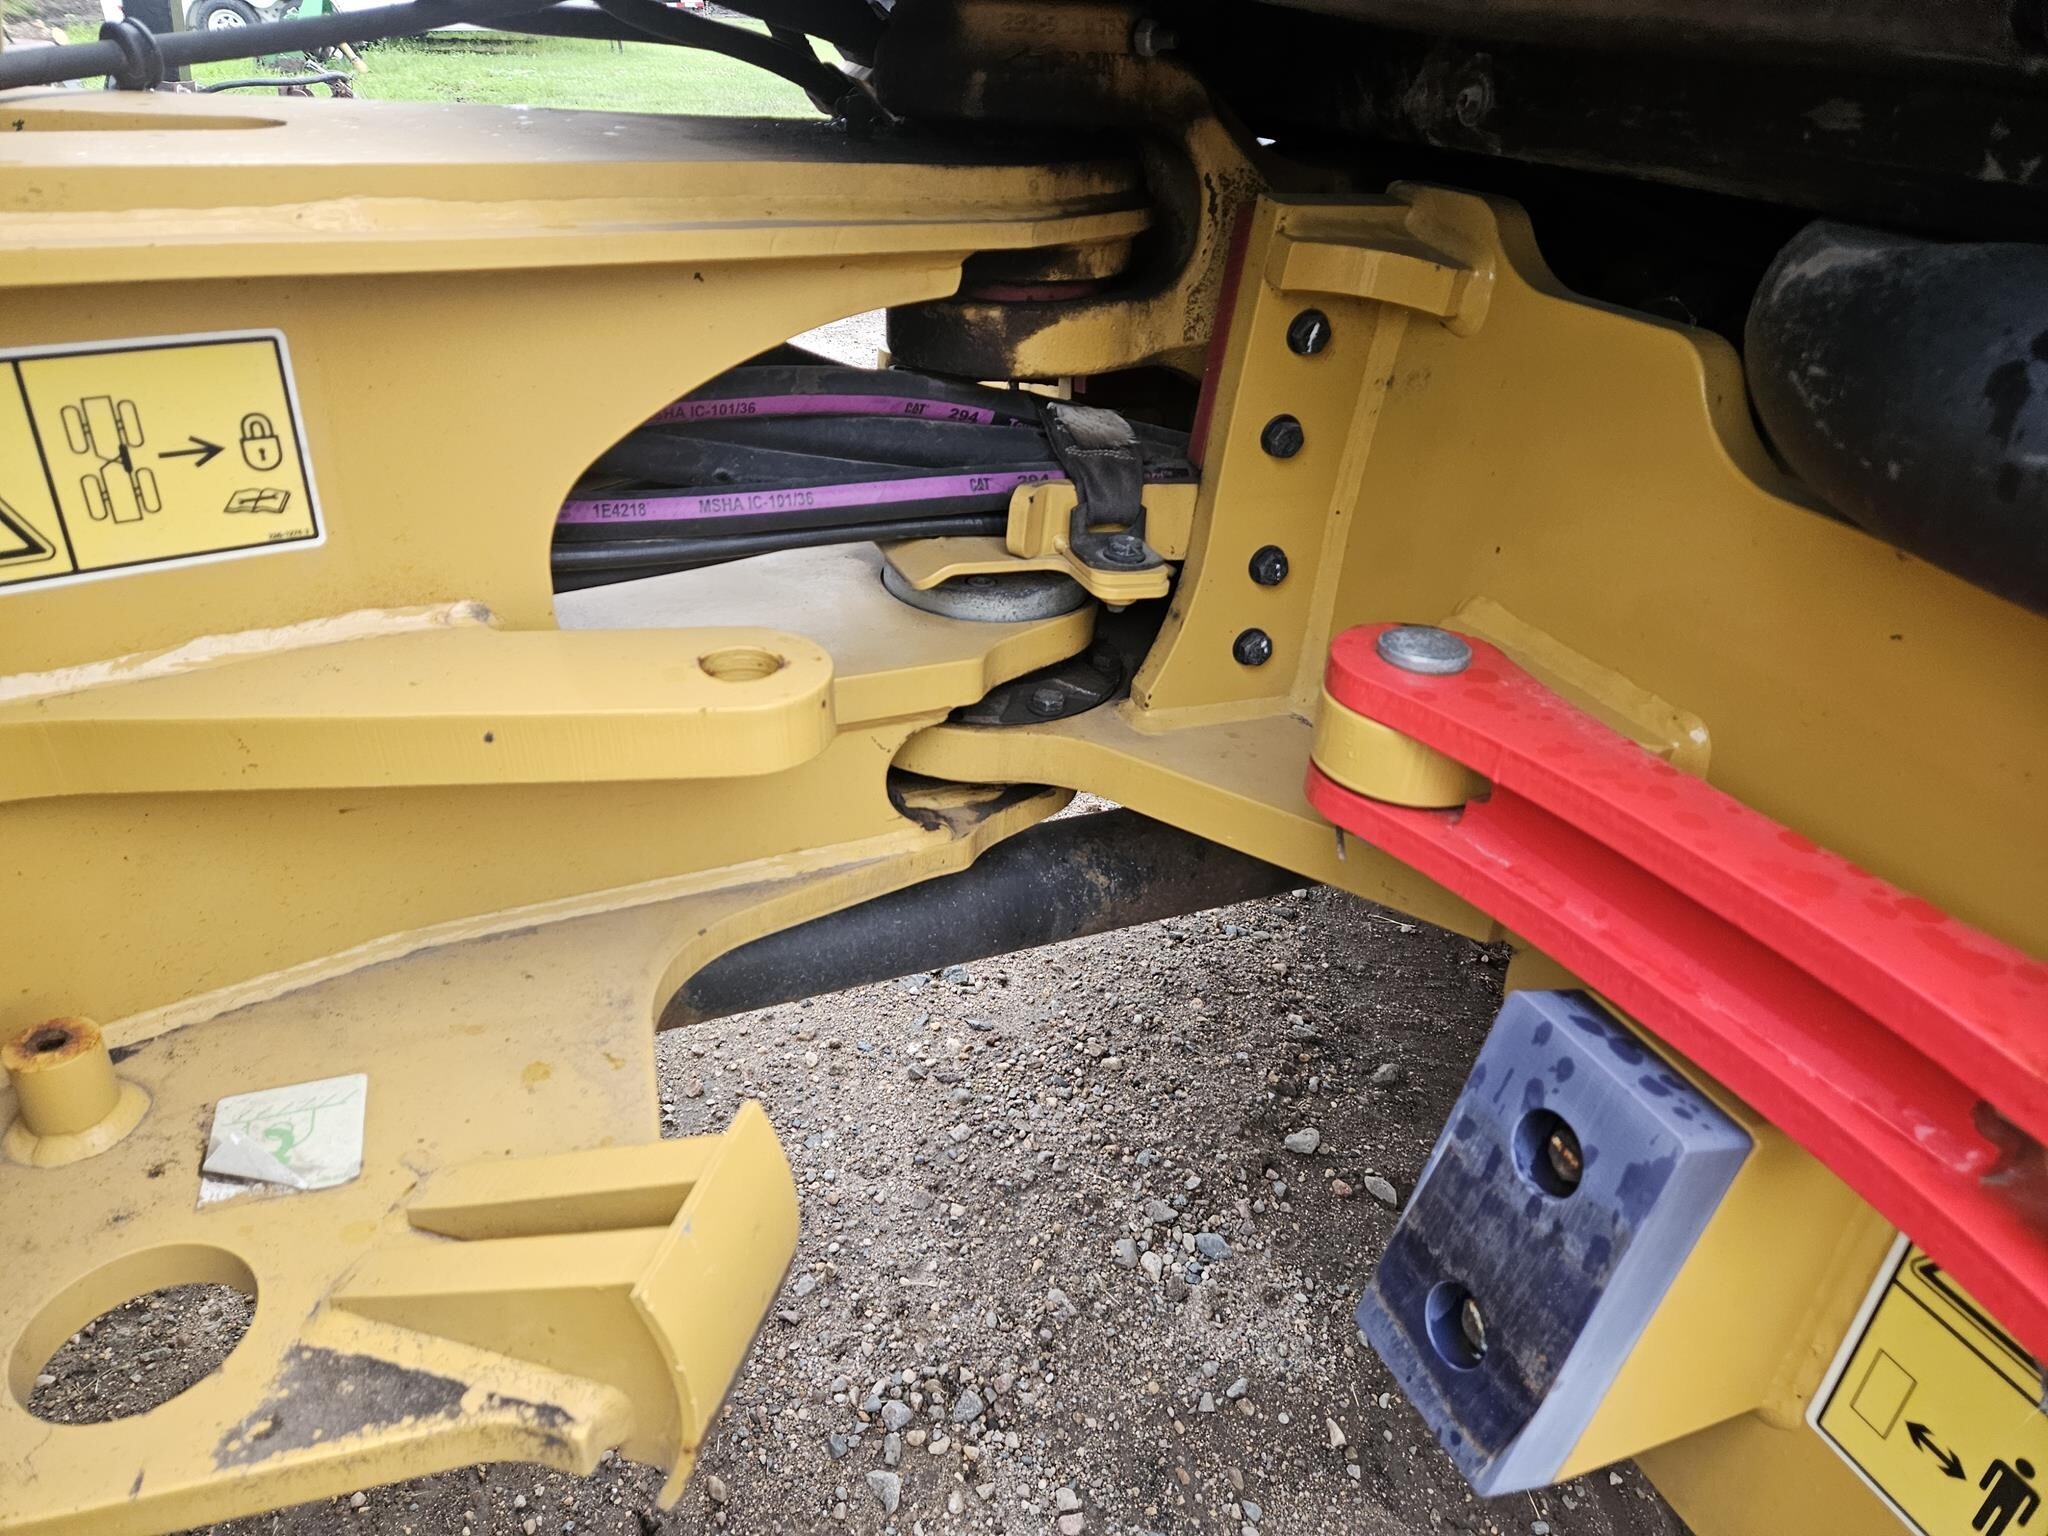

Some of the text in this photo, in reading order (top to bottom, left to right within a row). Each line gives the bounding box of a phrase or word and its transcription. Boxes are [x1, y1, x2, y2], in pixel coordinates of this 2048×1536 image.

[690, 401, 756, 418] IC-101/36
[904, 402, 928, 415] CAT
[947, 407, 979, 424] 294
[592, 503, 647, 519] 1E4218
[699, 497, 743, 514] MSHA
[748, 491, 814, 510] IC-101/36
[969, 477, 991, 492] CAT
